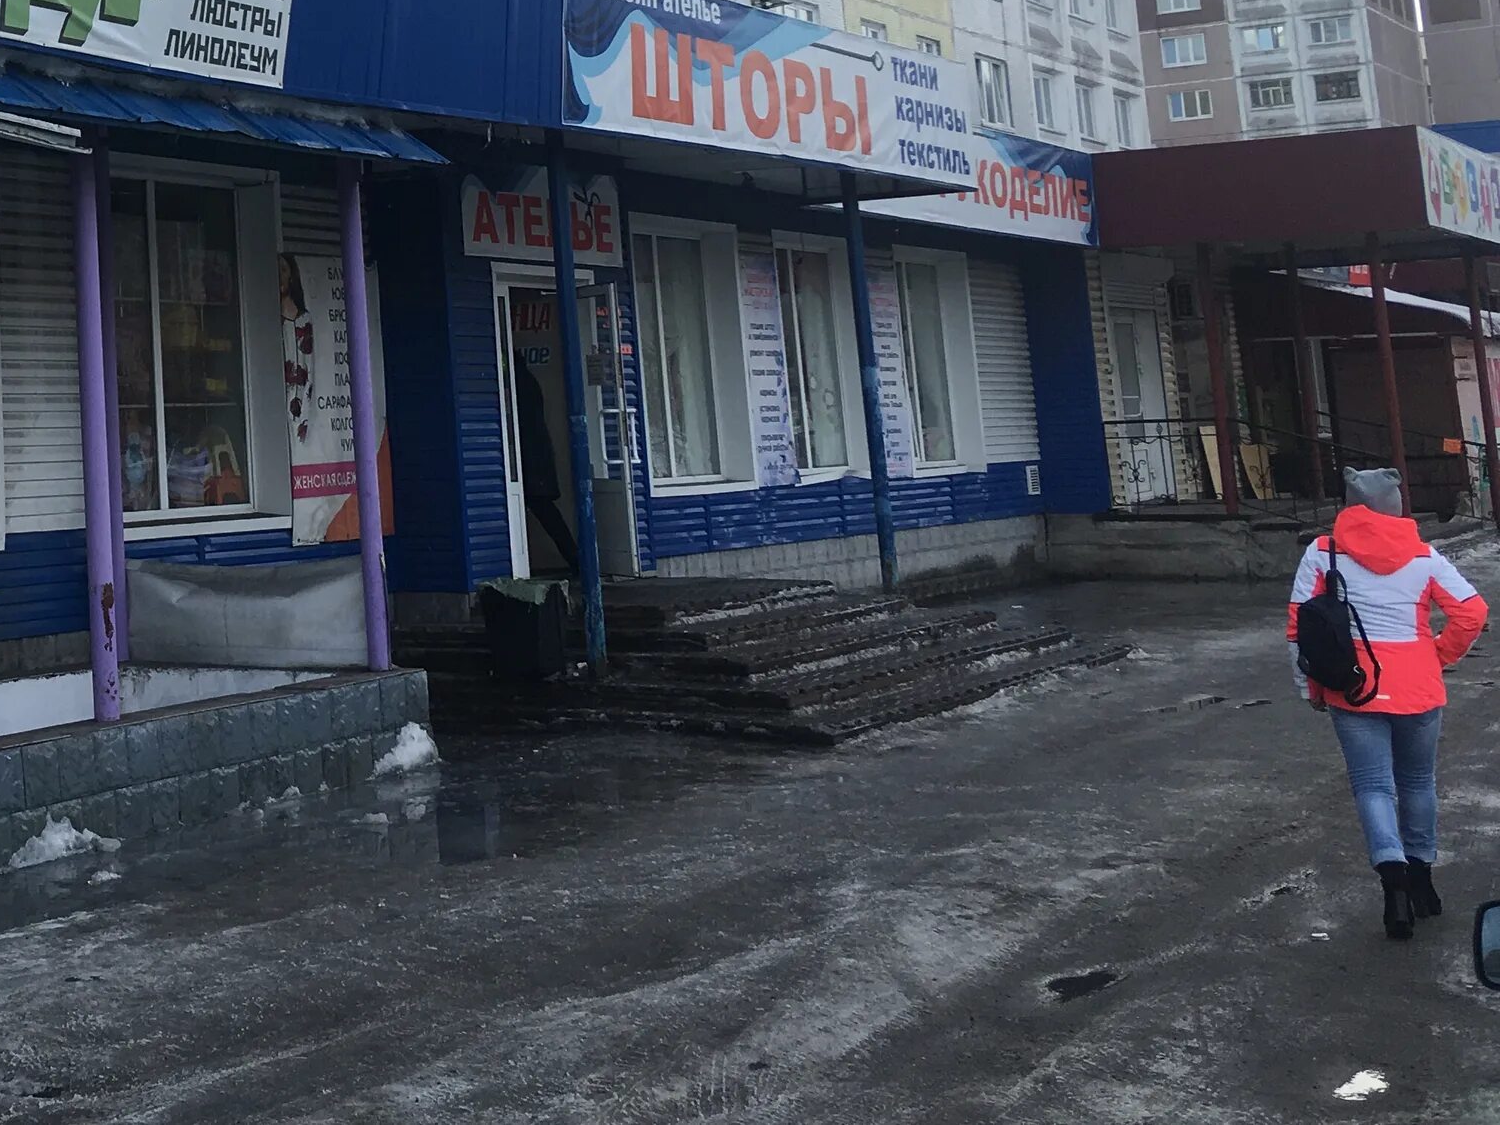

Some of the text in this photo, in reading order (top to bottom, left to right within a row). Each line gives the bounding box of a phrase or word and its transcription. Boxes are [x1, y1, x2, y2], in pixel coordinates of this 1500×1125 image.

[163, 28, 279, 76] ЛИНОЛЕУМ
[890, 56, 940, 93] ткани
[630, 22, 874, 156] ШТОРЫ
[895, 94, 968, 134] карнизы
[898, 138, 972, 178] текстиль
[940, 159, 1092, 222] КОДЕЛИЕ
[472, 190, 614, 253] АТЕЬЕ
